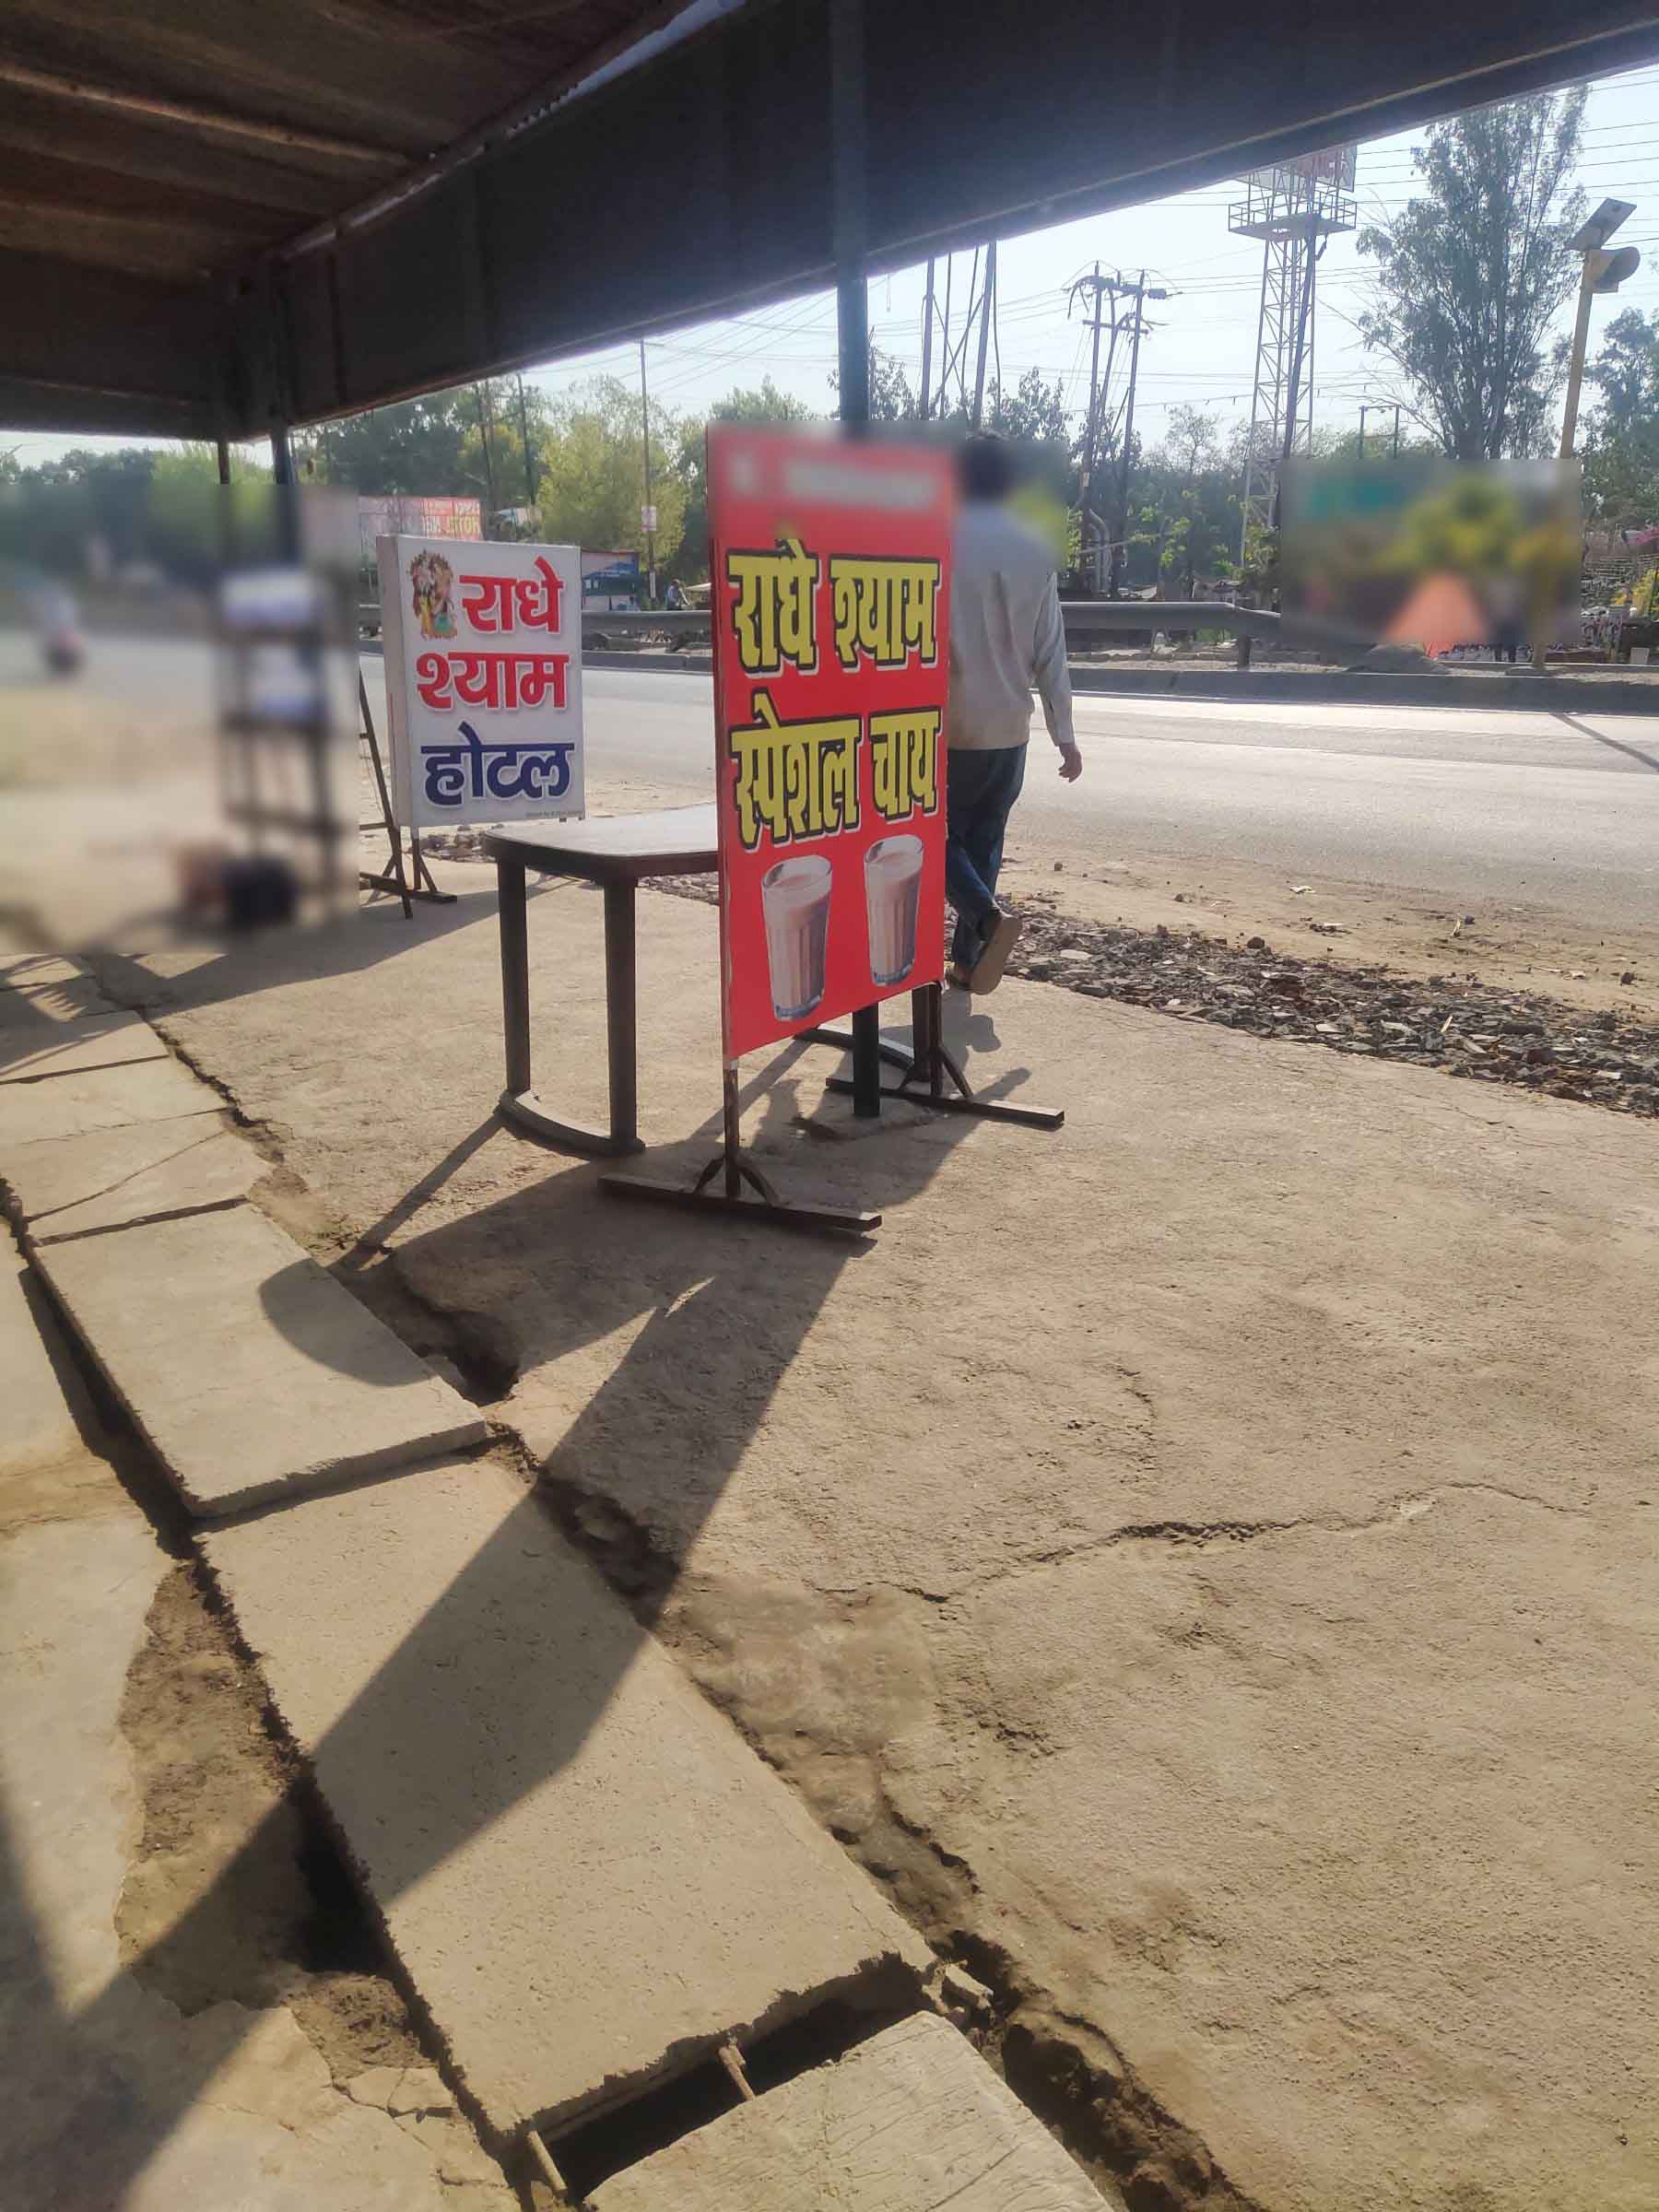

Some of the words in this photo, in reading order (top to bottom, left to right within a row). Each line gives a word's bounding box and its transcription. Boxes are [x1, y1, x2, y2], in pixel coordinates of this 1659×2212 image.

[460, 556, 564, 634] राधे
[727, 532, 818, 675] राधे
[830, 553, 940, 669] श्याम
[416, 652, 570, 709] श्याम
[420, 722, 575, 806] होटल
[731, 688, 861, 850] स्पेशल
[869, 708, 941, 820] चाय
